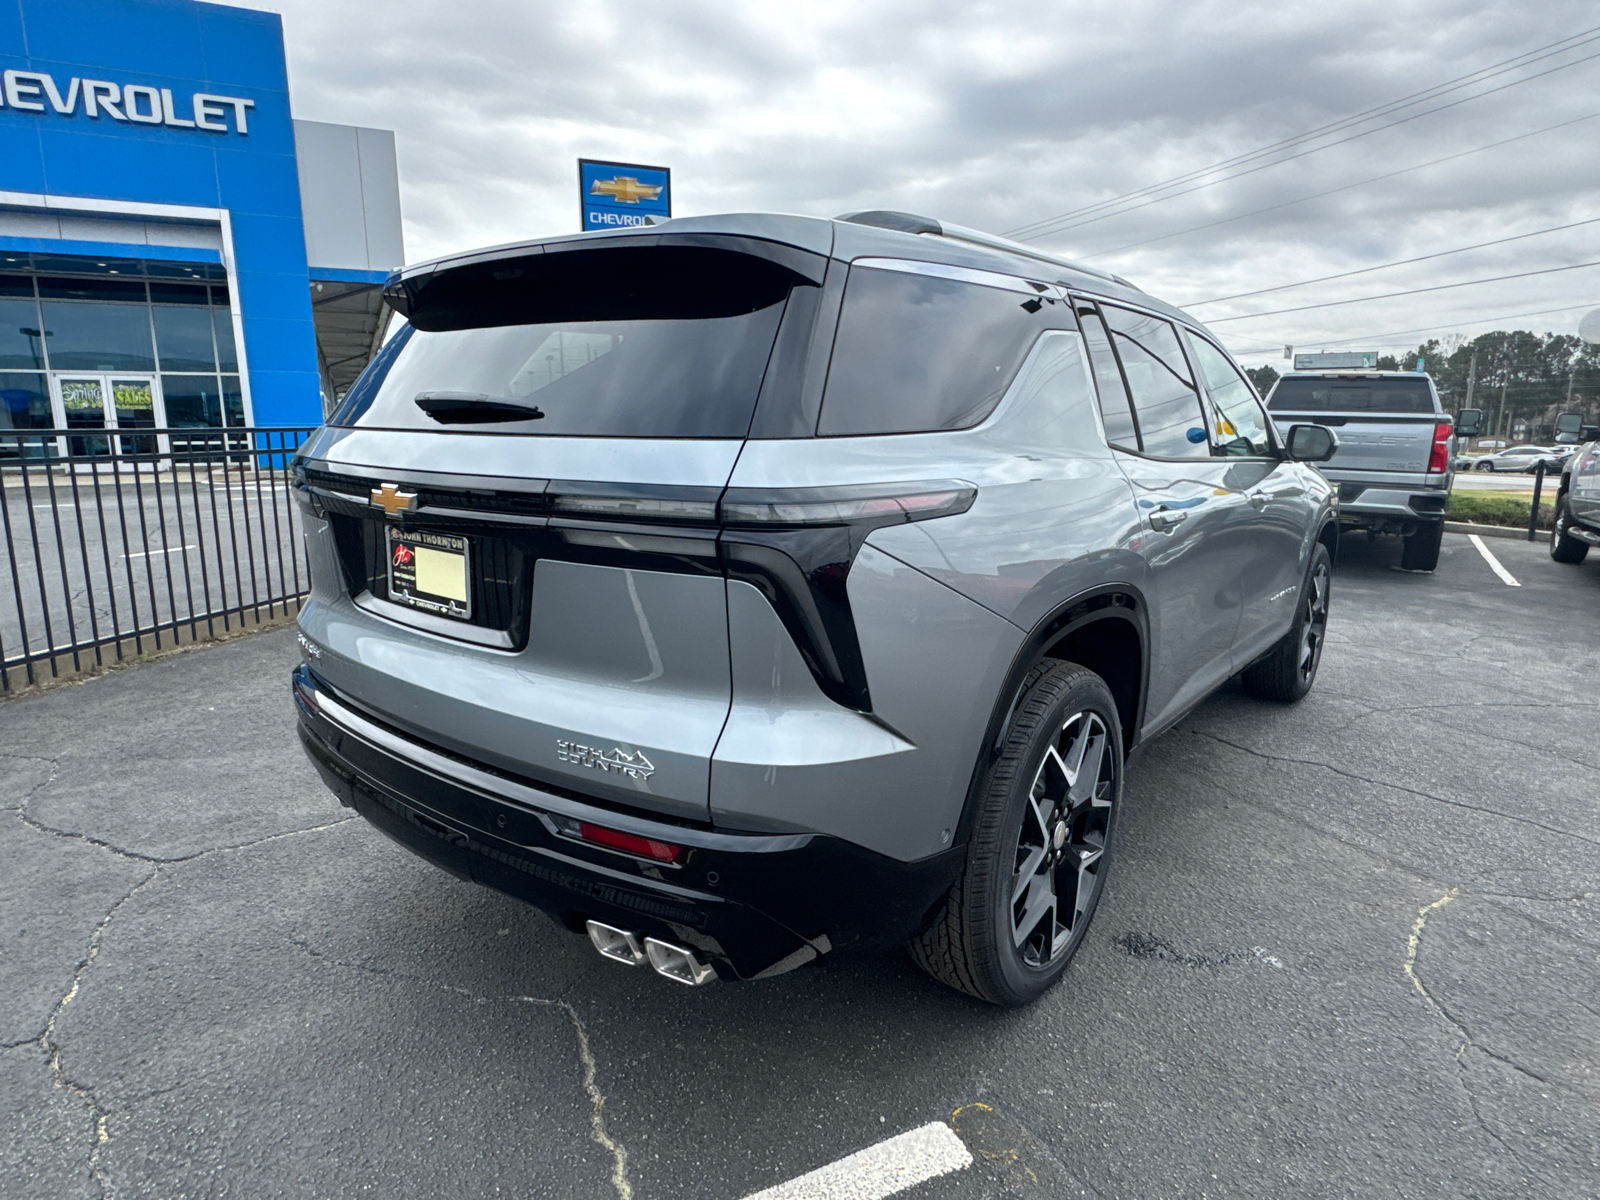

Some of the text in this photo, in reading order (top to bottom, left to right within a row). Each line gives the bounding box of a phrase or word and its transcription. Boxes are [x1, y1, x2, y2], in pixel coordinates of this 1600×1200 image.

[0, 70, 254, 134] EVROLET
[403, 532, 463, 549] JOHN THORNTON
[415, 600, 440, 611] CHEVROLET
[556, 739, 603, 756] HIGH
[557, 750, 655, 781] COUNTRY
